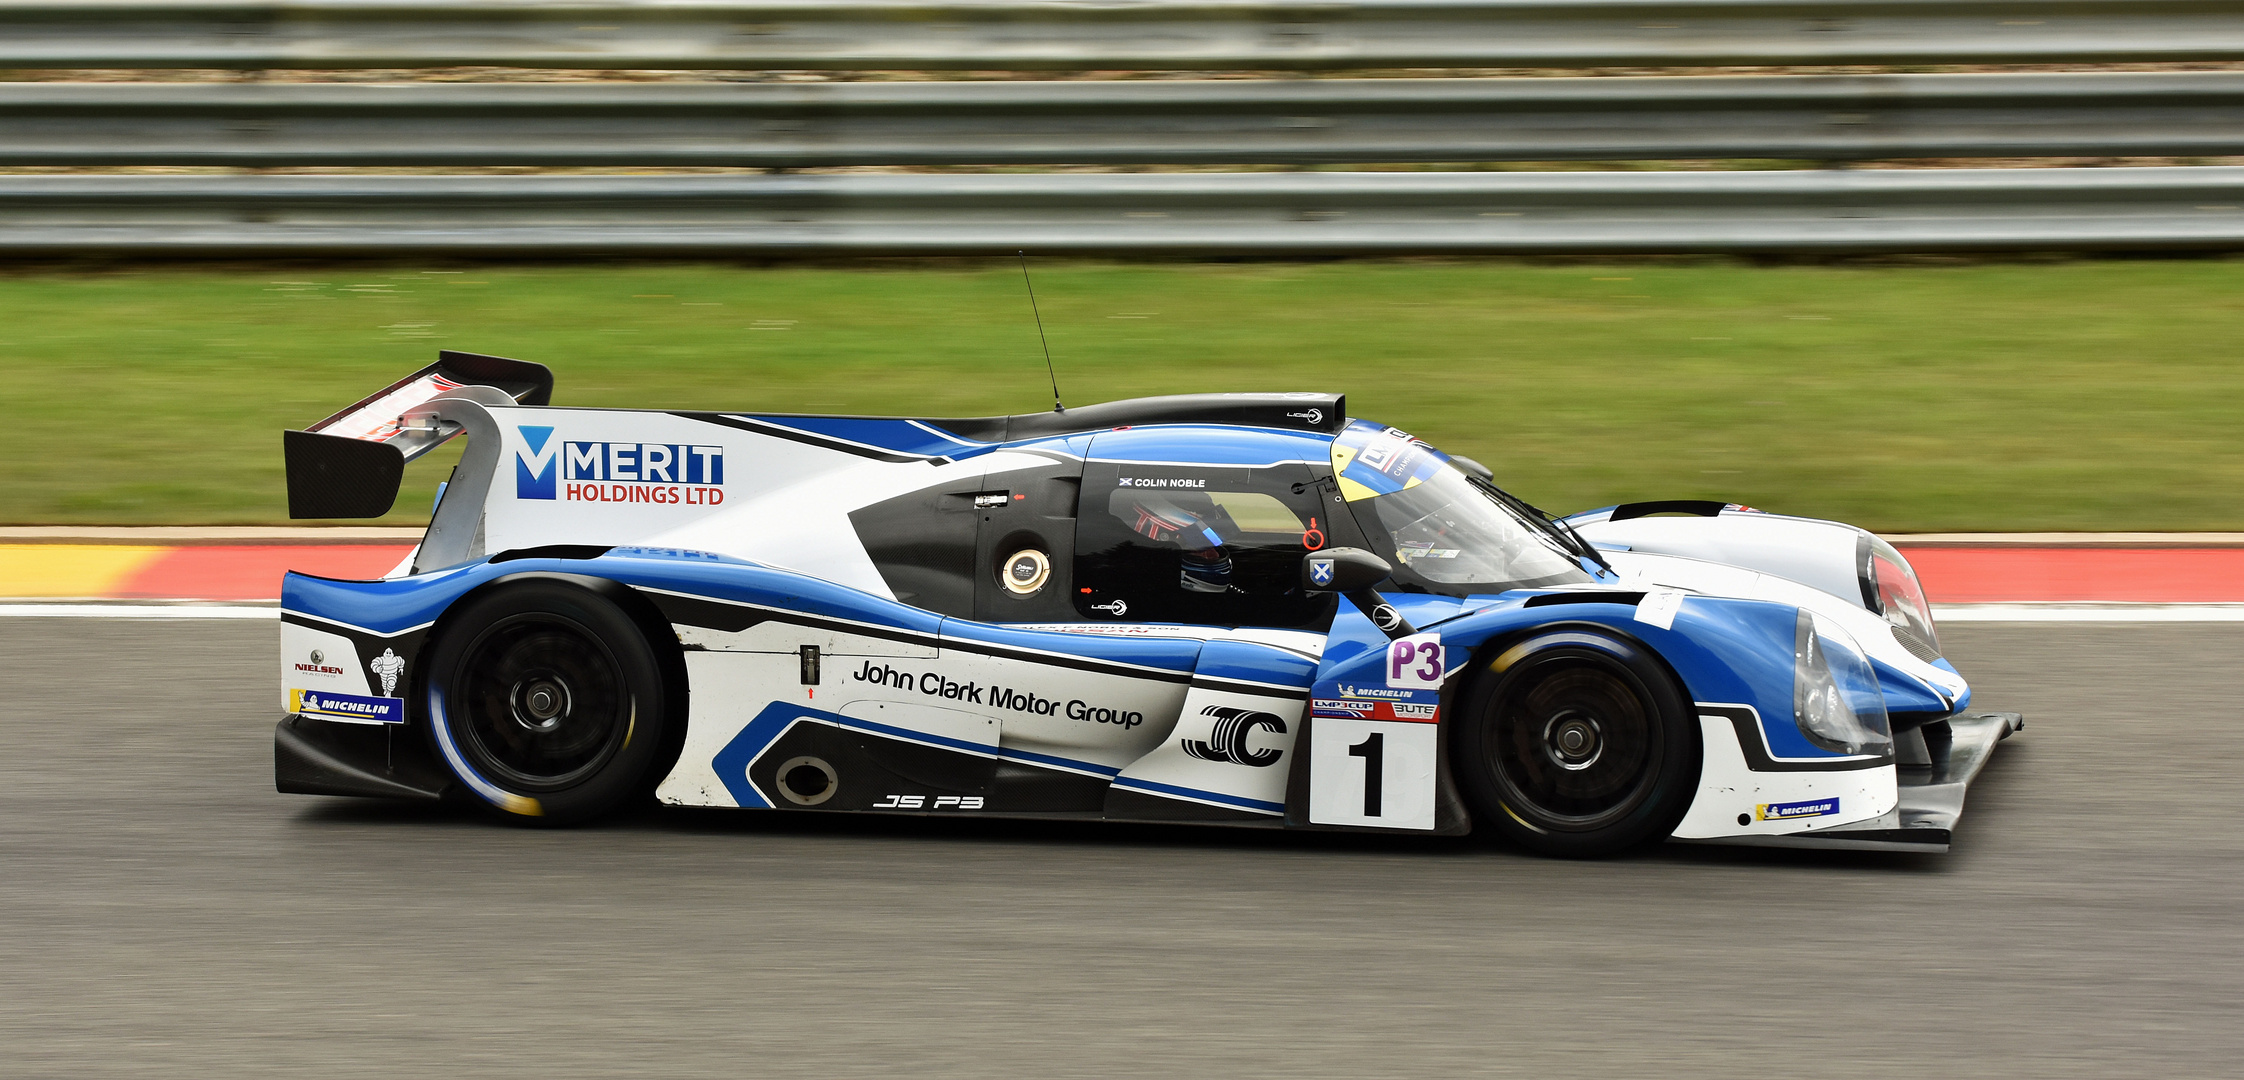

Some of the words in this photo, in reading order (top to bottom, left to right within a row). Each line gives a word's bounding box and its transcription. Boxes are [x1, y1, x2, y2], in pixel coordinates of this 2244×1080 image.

[565, 442, 723, 484] MERIT
[1134, 478, 1168, 487] COLIN
[1169, 479, 1206, 488] NOBLE
[566, 483, 680, 504] HOLDINGS
[686, 486, 724, 506] LTD
[294, 663, 344, 675] NIELSEN
[1392, 641, 1442, 681] P3
[853, 660, 914, 691] John
[919, 672, 983, 705] Clark
[988, 685, 1061, 717] Motor
[1065, 699, 1144, 730] Group
[1356, 688, 1413, 698] MICHELIN
[321, 699, 390, 715] MICHELIN
[1393, 703, 1435, 714] BUTE
[1348, 732, 1384, 817] 1
[872, 794, 926, 809] JS
[933, 795, 985, 810] P3
[1780, 803, 1832, 815] MICHELIN
